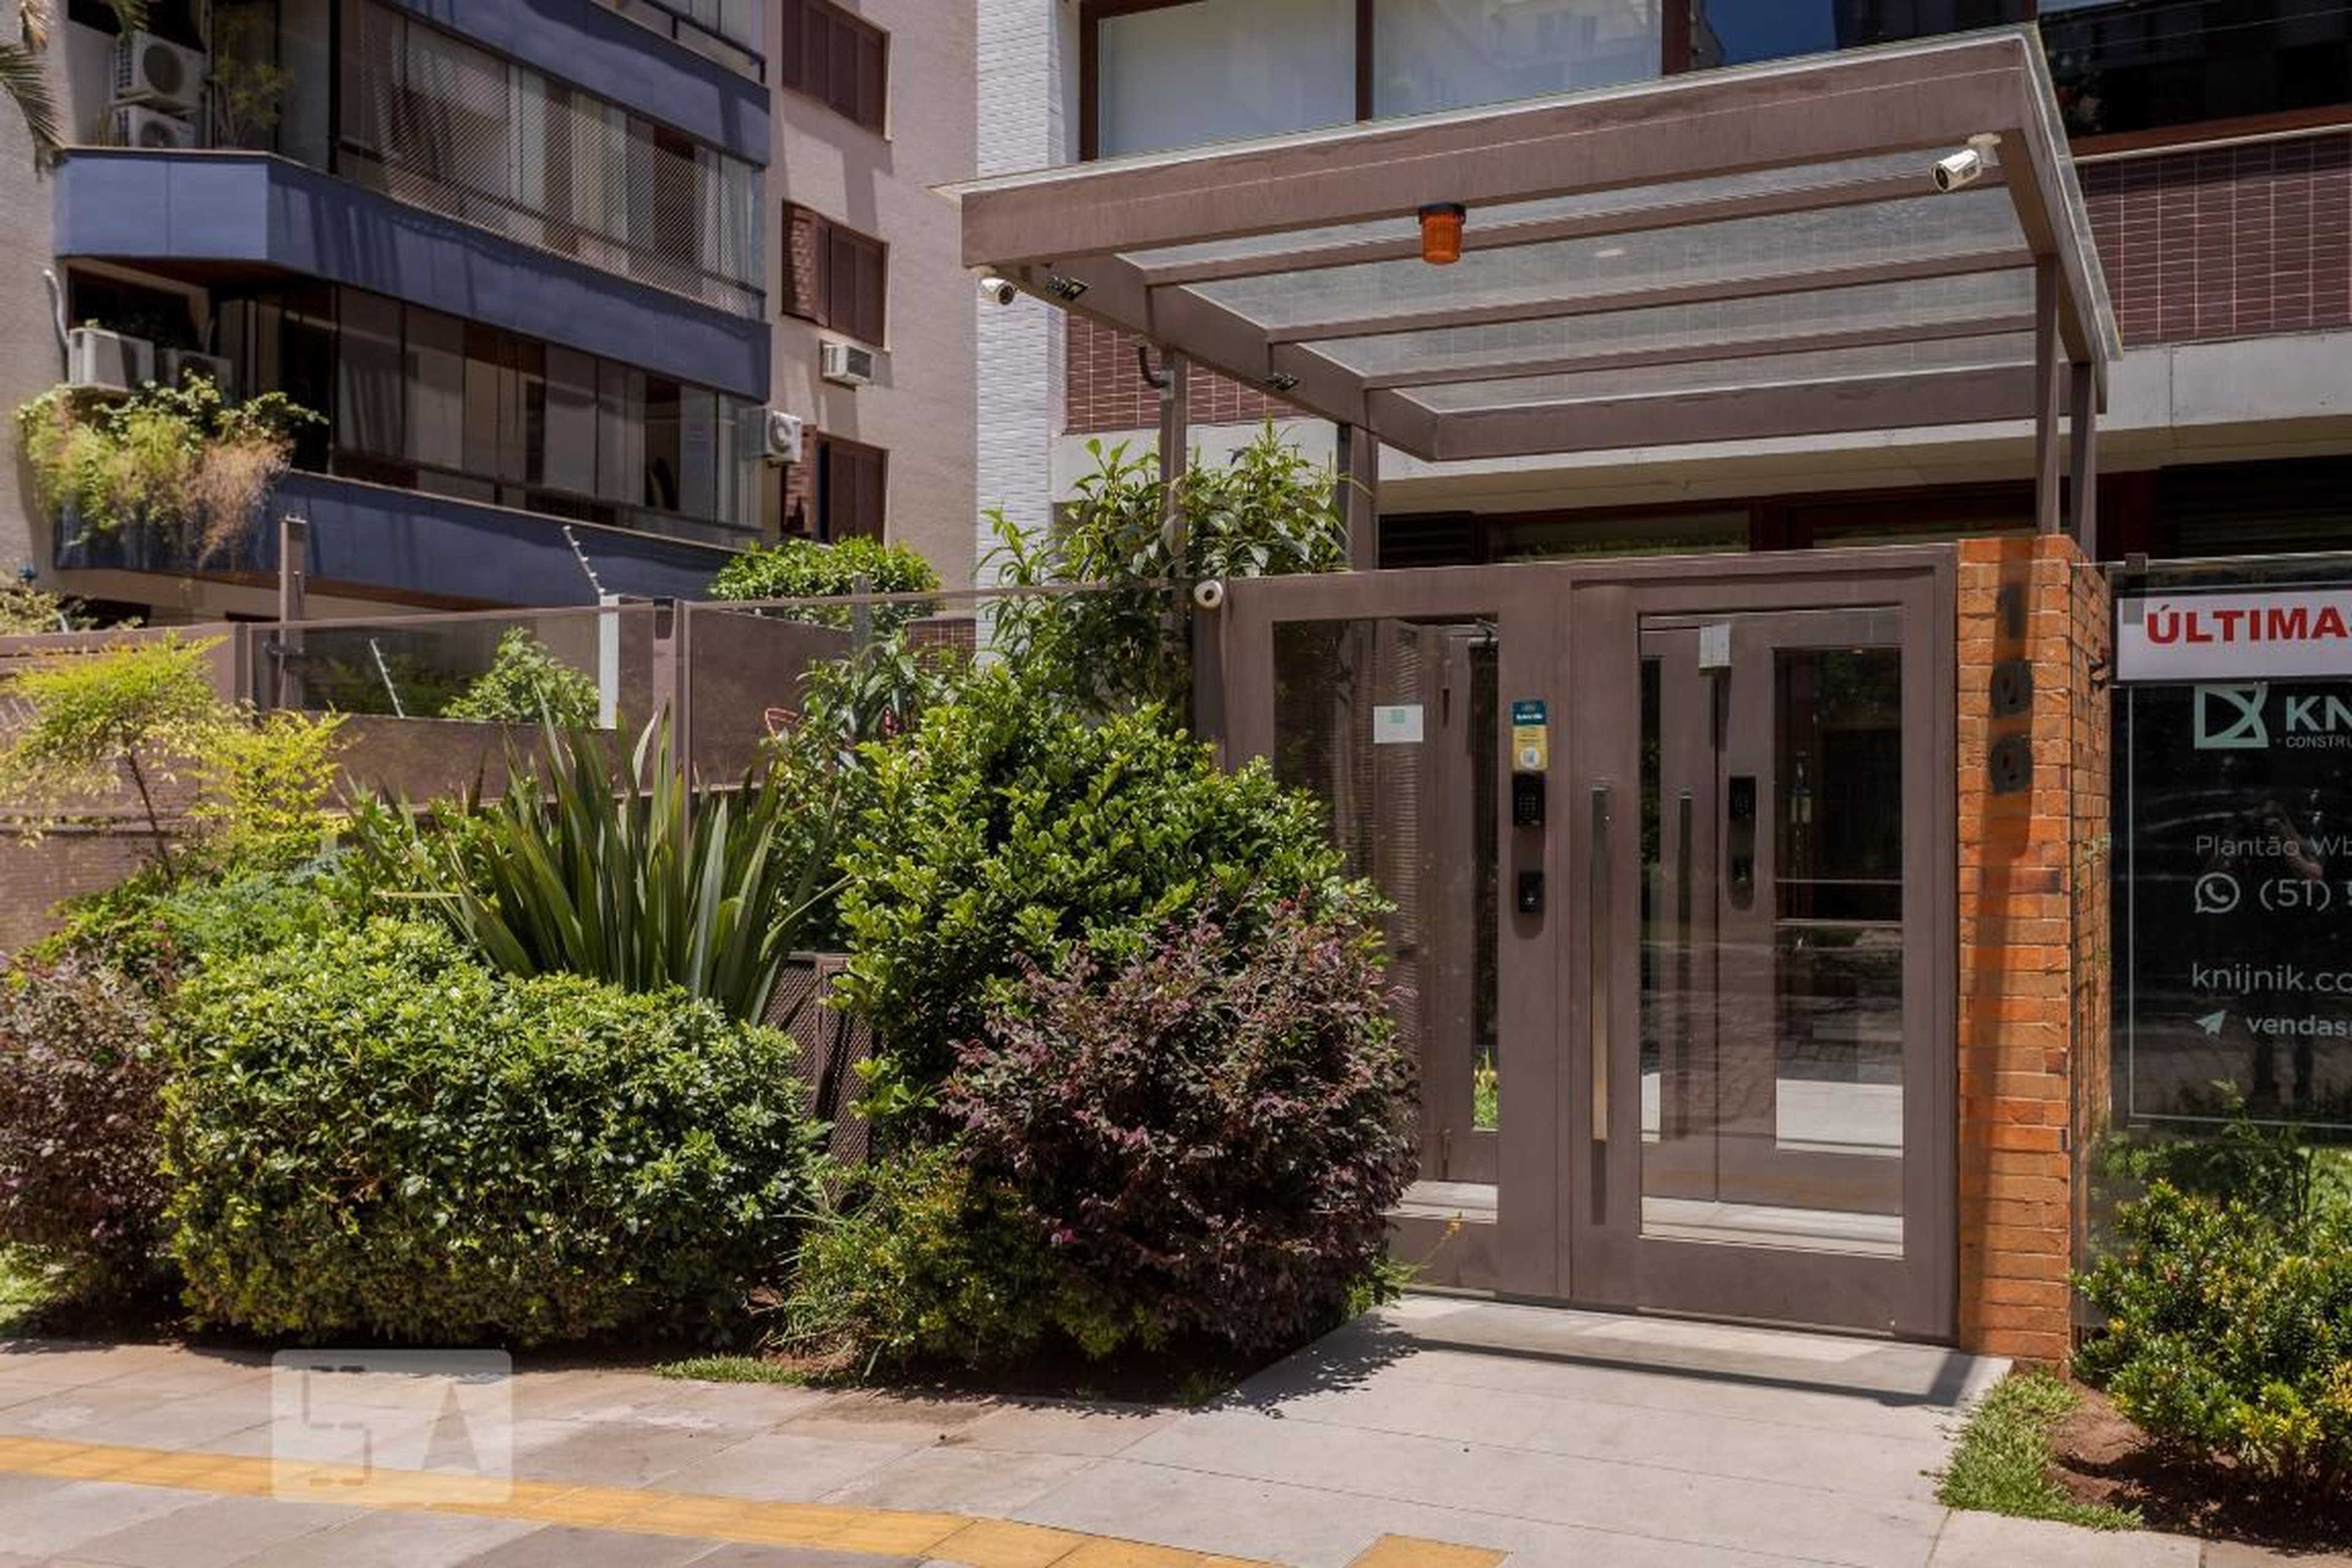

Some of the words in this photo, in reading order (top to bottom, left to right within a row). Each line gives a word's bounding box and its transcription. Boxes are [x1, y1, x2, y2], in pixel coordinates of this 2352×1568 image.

[2147, 604, 2352, 644] ÚLTIMA
[2285, 696, 2352, 732] KN
[2195, 834, 2301, 858] Plantão
[2259, 878, 2332, 912] (51)
[2192, 962, 2352, 995] knijnik.co
[2245, 1014, 2352, 1037] vendas
